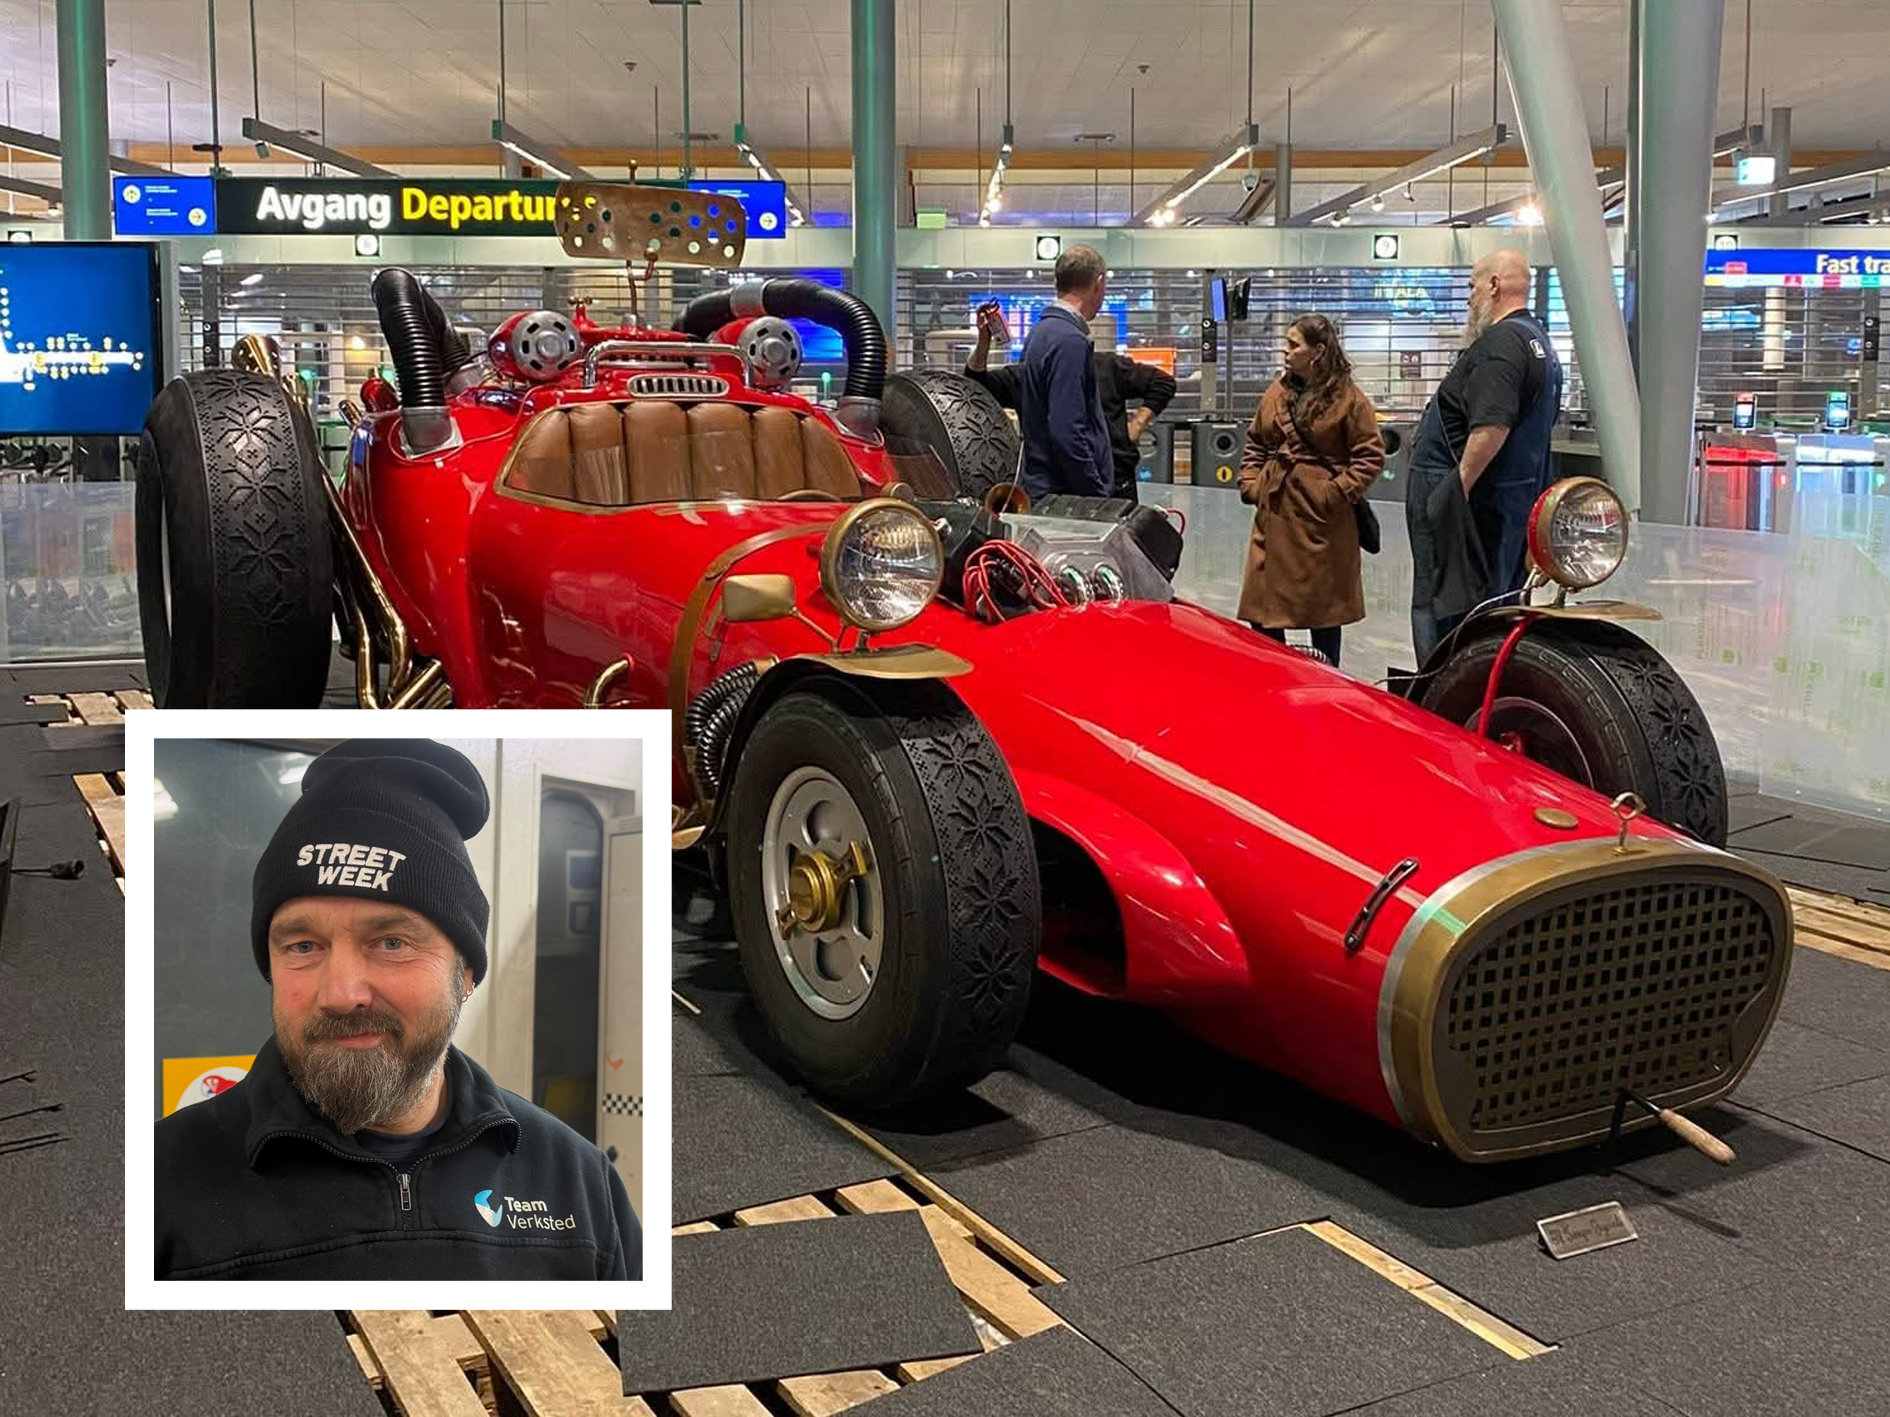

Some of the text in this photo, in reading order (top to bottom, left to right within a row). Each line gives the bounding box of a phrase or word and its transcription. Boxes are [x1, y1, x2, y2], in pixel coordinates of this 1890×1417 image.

[256, 186, 597, 229] Avgang Departur
[1816, 254, 1859, 273] Fast
[297, 843, 407, 872] STREET
[317, 865, 394, 892] WEEK
[504, 1196, 548, 1213] Team
[506, 1214, 576, 1231] Verksted
